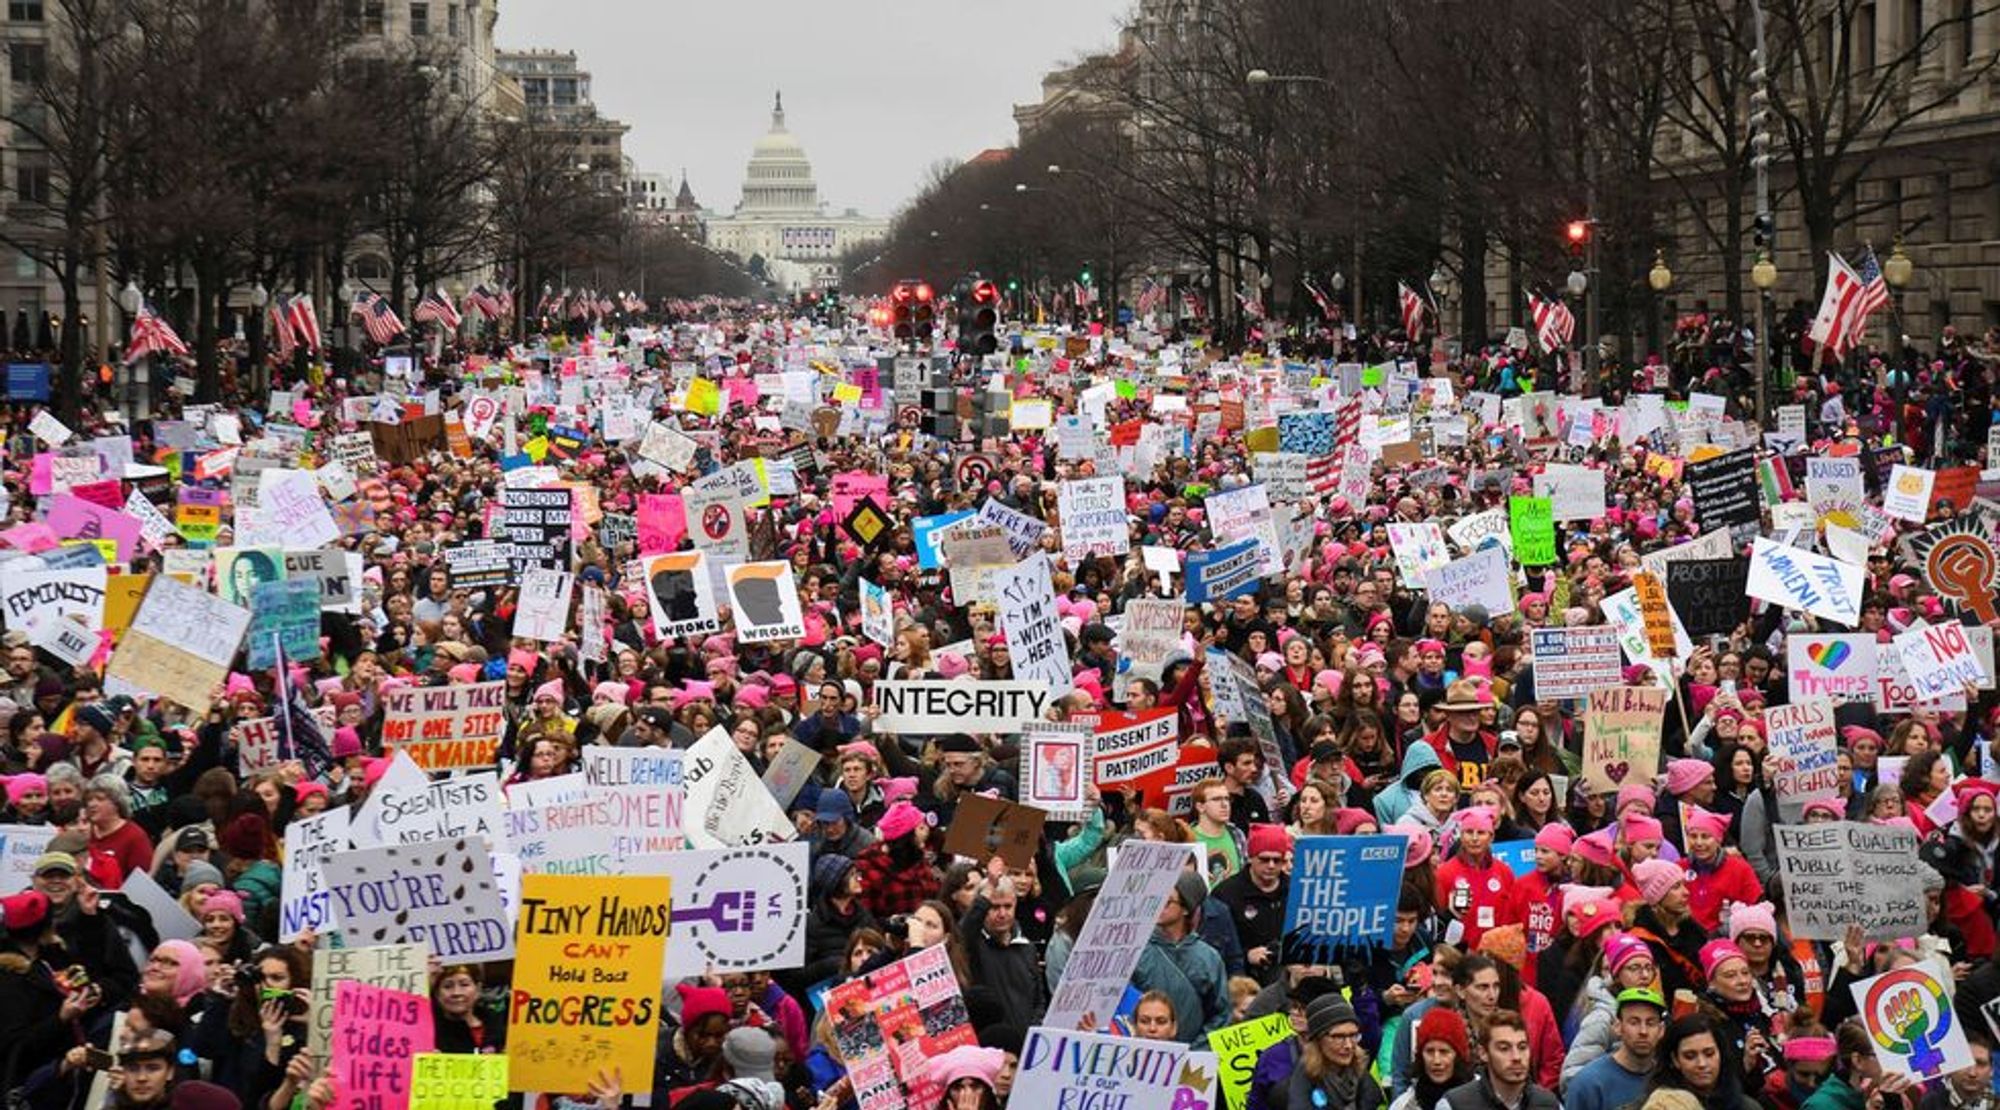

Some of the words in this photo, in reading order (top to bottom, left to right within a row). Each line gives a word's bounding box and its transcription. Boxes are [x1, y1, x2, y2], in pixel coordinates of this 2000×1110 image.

[1811, 462, 1855, 478] RAISED
[506, 492, 569, 505] NOBODY
[506, 510, 542, 523] PUTS
[546, 510, 569, 523] MY
[514, 545, 554, 559] AKER
[1206, 555, 1242, 579] DISSENT
[8, 581, 105, 617] FEMINIST
[1022, 603, 1042, 624] I'M
[660, 619, 716, 637] WRONG
[742, 626, 802, 640] WRONG
[1019, 618, 1053, 645] WITH
[58, 630, 86, 653] ALLY
[1028, 641, 1054, 664] HER
[1924, 622, 1970, 664] NOT
[390, 694, 415, 712] WE
[423, 692, 458, 711] WILL
[467, 686, 503, 708] TAKE
[876, 687, 1047, 718] INTEGRITY
[384, 721, 415, 740] NOT
[422, 717, 453, 738] ONE
[462, 714, 500, 735] STEP
[1769, 701, 1824, 729] GIRLS
[1097, 725, 1153, 752] DISSENT
[1157, 720, 1170, 736] IS
[1771, 728, 1803, 749] JUST
[383, 738, 497, 770] BCKWARDS
[1106, 748, 1169, 778] PATRIOTIC
[584, 757, 628, 786] WELL
[1777, 770, 1839, 796] RIGHTS
[546, 802, 607, 832] RIGHTS
[603, 791, 683, 829] OMEN
[301, 818, 327, 844] THE
[476, 818, 490, 834] A
[1780, 828, 1841, 849] FREE
[1848, 829, 1915, 850] QUALITY
[1304, 849, 1346, 877] WE
[1363, 847, 1398, 861] ACLU
[1786, 857, 1844, 875] PUBLIC
[1855, 860, 1917, 876] SCHOOLS
[307, 872, 317, 891] IS
[334, 869, 451, 917] YOU'RE
[1121, 874, 1151, 895] NOT
[1300, 878, 1348, 907] THE
[1791, 882, 1824, 895] ARE
[1832, 882, 1865, 895] THE
[283, 893, 331, 935] NAST
[522, 898, 590, 936] TINY
[768, 892, 782, 918] WE
[1296, 904, 1389, 936] PEOPLE
[1806, 913, 1819, 926] A
[409, 918, 506, 956] FIRED
[327, 952, 357, 974] BE
[373, 947, 412, 971] THE
[549, 965, 586, 982] Hold
[914, 967, 950, 987] ARE
[343, 988, 419, 1026] rising
[512, 989, 653, 1026] PROGRESS
[344, 1022, 411, 1059] tides
[1220, 1027, 1255, 1051] WE
[1024, 1032, 1185, 1087] DIVERSITY
[351, 1060, 402, 1092] lift
[860, 1078, 898, 1101] ARE
